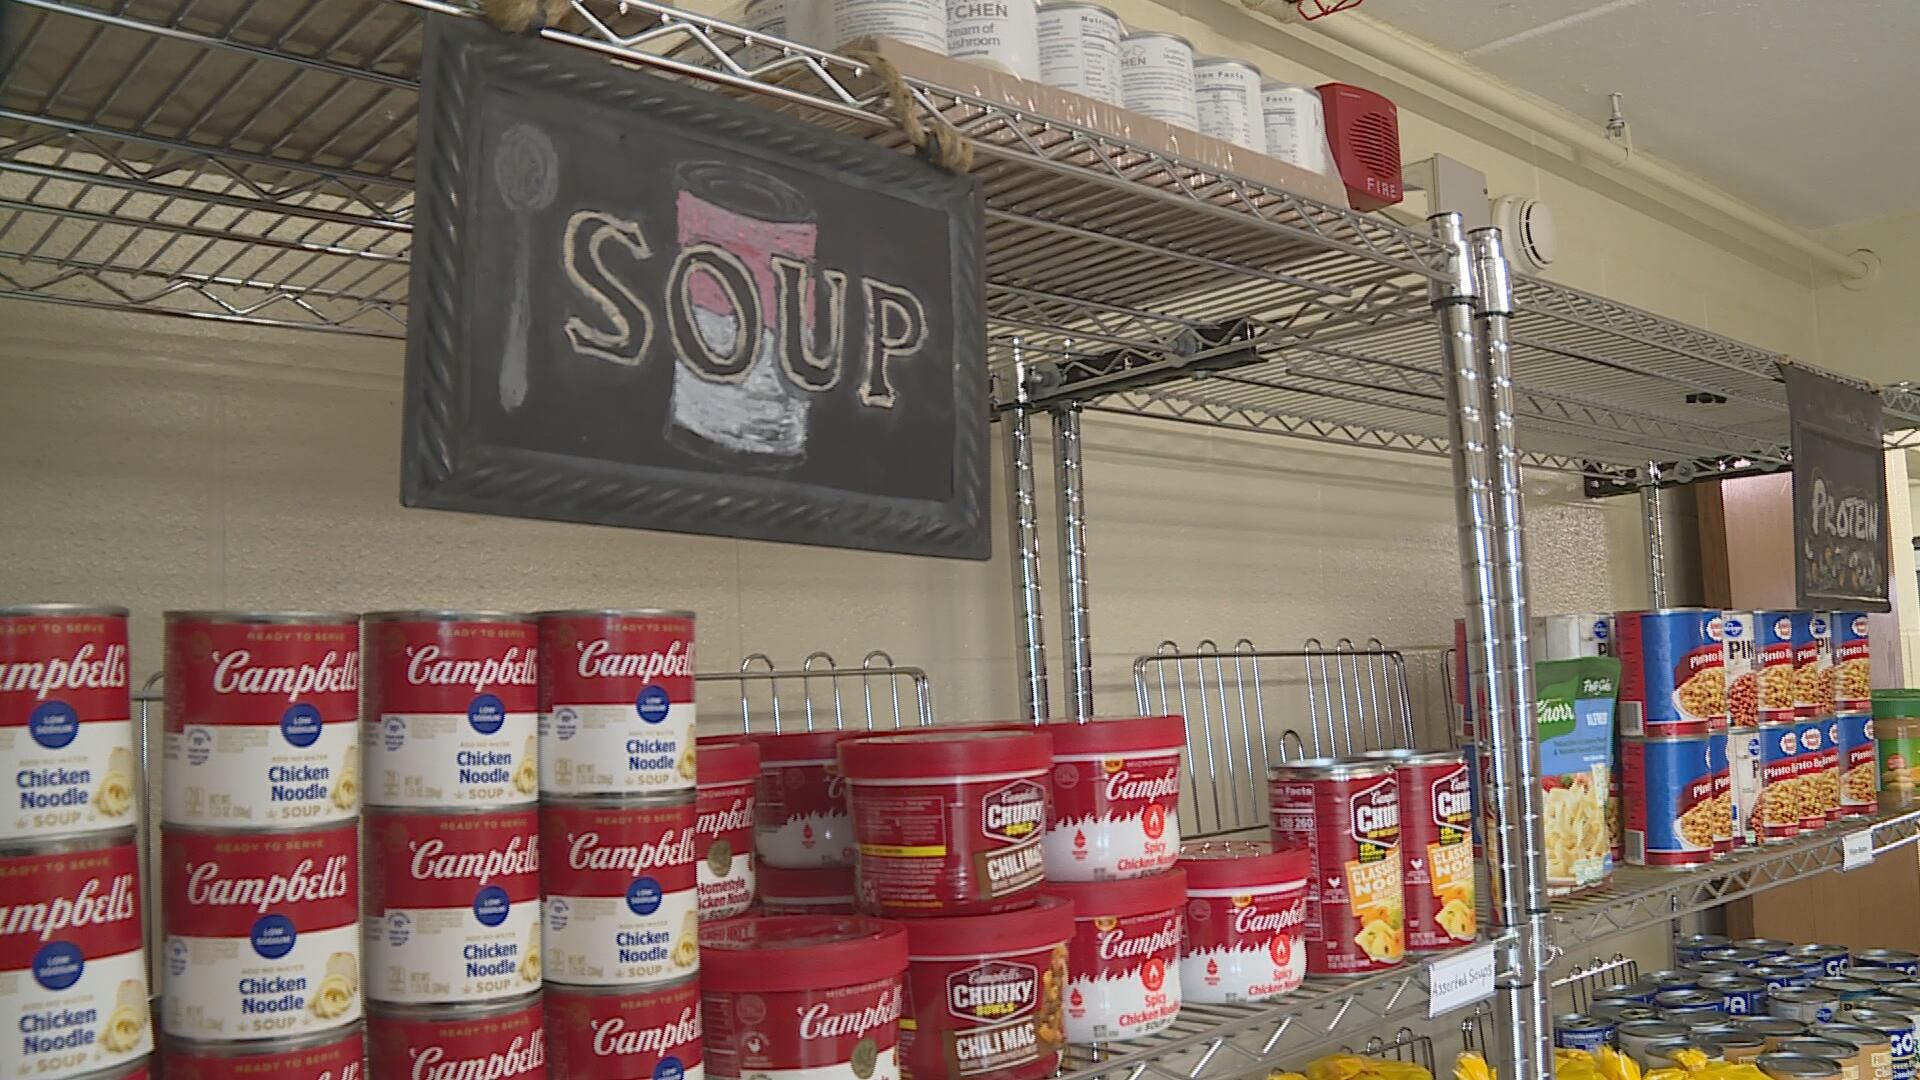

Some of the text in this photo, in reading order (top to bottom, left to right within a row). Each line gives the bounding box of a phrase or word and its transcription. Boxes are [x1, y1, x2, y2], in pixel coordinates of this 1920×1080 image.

[983, 22, 994, 34] of
[1367, 177, 1397, 198] FIRE
[564, 210, 928, 408] SOUP
[1812, 478, 1878, 542] PROTEIN
[0, 624, 37, 634] EADY
[1758, 650, 1785, 664] Pinto
[1836, 645, 1862, 659] Pinto
[626, 740, 676, 754] Chicken
[457, 750, 512, 767] Chicken
[628, 756, 675, 771] Noodle
[17, 768, 90, 788] Chicken
[268, 765, 329, 784] Chicken
[459, 769, 510, 784] Noodle
[638, 774, 670, 786] SOUP
[20, 787, 89, 809] Noodle
[271, 783, 327, 802] Noodle
[469, 787, 504, 799] SOUP
[33, 812, 80, 827] SOUP
[282, 805, 321, 818] SOUP
[988, 801, 1044, 829] CHUNKY
[1144, 842, 1166, 855] Spicy
[988, 851, 1025, 881] CHILI
[1118, 857, 1156, 872] Chicken
[186, 854, 348, 913] Campbell's
[616, 930, 670, 947] Chicken
[464, 942, 518, 961] Chicken
[619, 947, 669, 964] Noodle
[466, 960, 516, 978] Noodle
[628, 965, 663, 979] SOUP
[1272, 968, 1293, 980] Spicy
[239, 976, 306, 996] Chicken
[476, 980, 511, 993] SOUP
[953, 979, 1034, 1008] CHUNKY
[1248, 983, 1282, 996] Chicken
[242, 994, 305, 1015] Noodle
[974, 1002, 1016, 1017] BOWLS
[1145, 994, 1167, 1008] Spicy
[19, 1008, 97, 1033] Chicken
[253, 1017, 297, 1032] SOUP
[1119, 1010, 1158, 1027] Chicken
[24, 1029, 95, 1055] Noodle
[956, 1032, 1001, 1060] CHILI
[1001, 1023, 1036, 1051] MAC
[36, 1053, 87, 1074] SOUP
